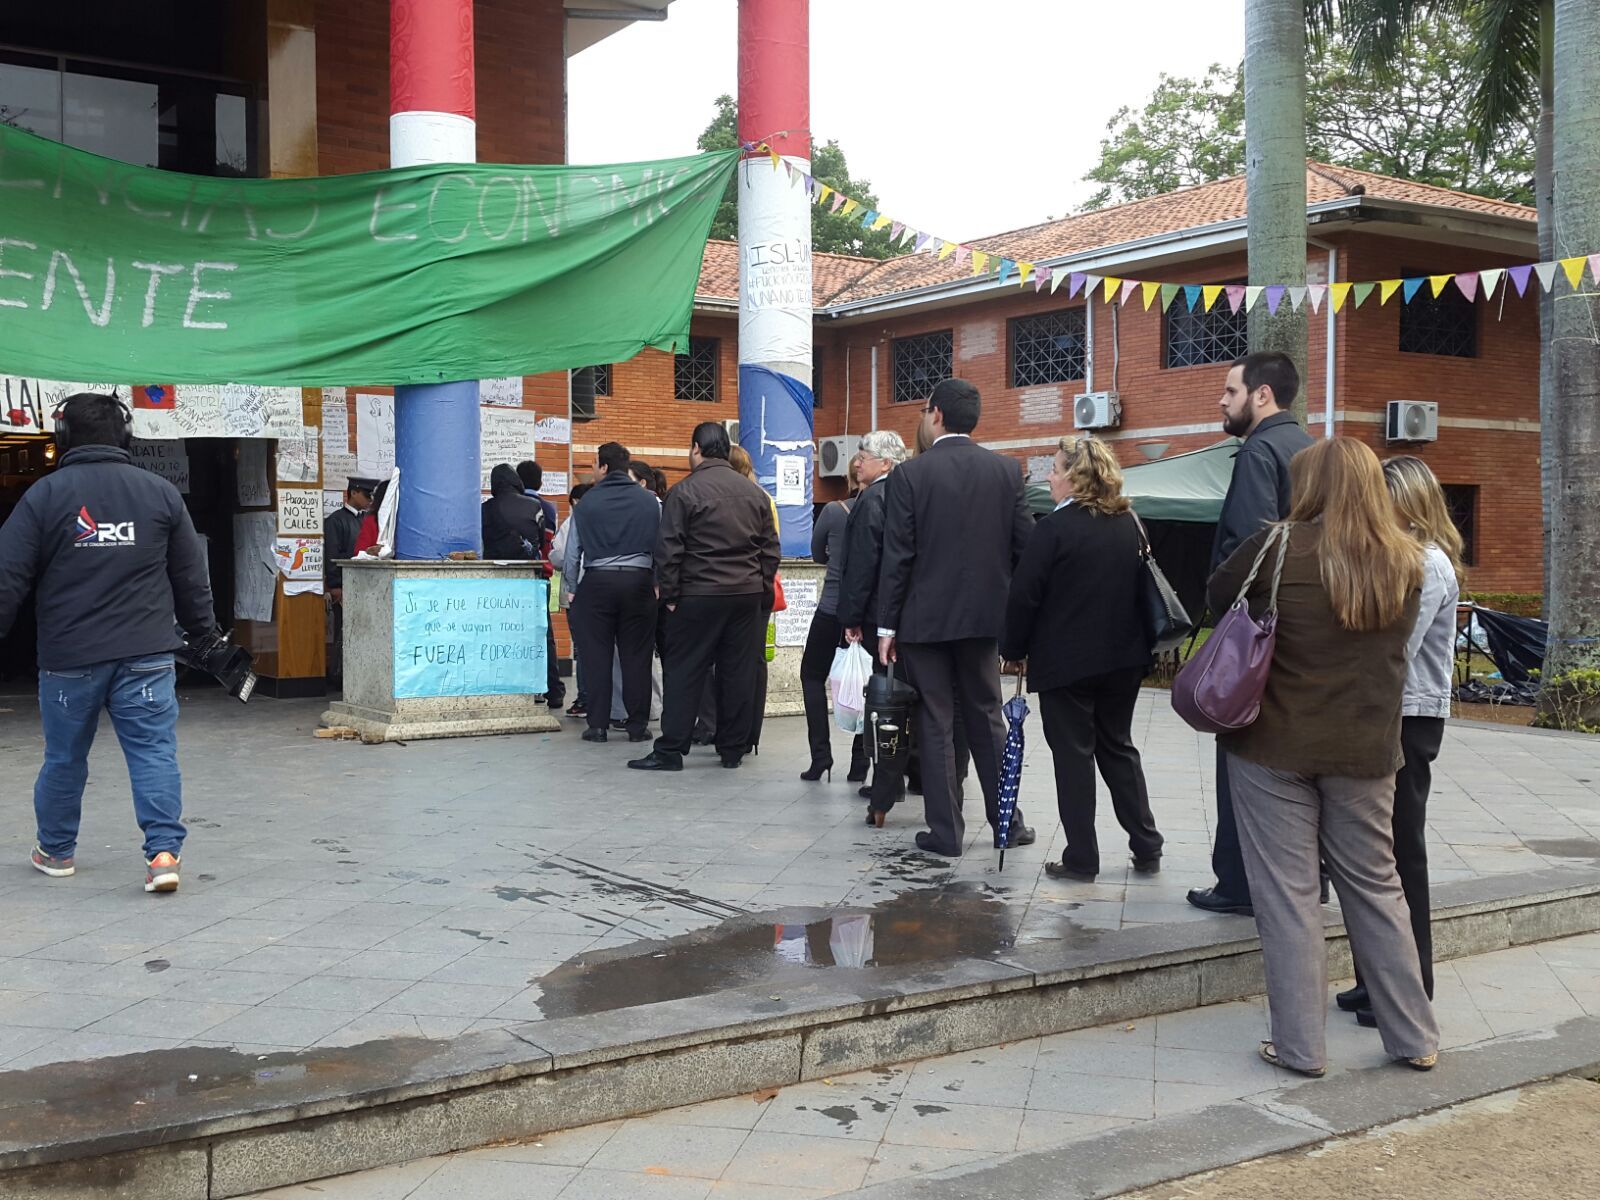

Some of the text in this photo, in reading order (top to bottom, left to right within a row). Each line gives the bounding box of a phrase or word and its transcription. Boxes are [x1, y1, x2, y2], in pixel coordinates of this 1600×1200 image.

[284, 506, 316, 518] NO TE
[284, 518, 319, 530] CALLES
[412, 644, 467, 666] FUERA
